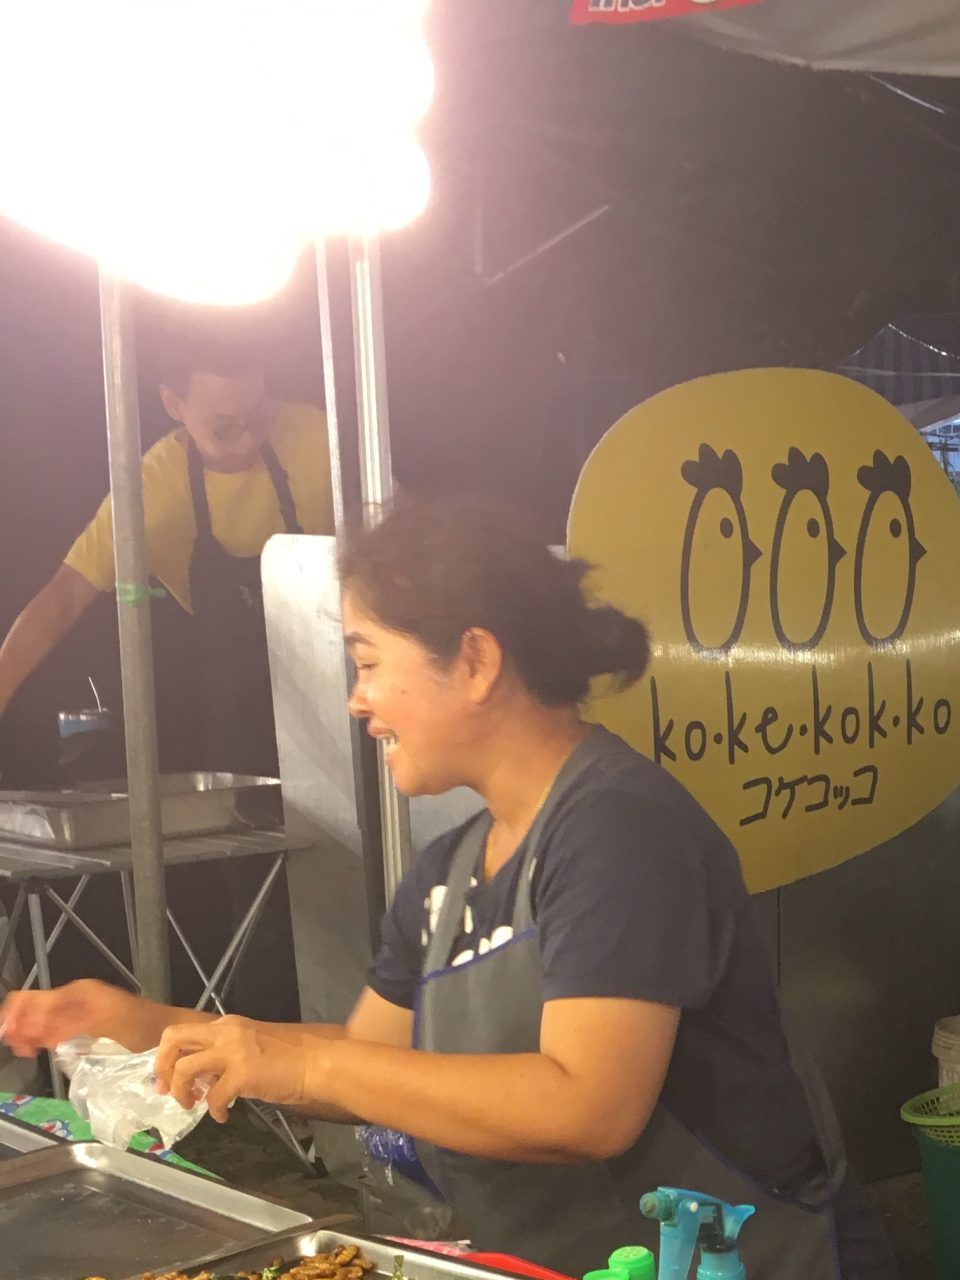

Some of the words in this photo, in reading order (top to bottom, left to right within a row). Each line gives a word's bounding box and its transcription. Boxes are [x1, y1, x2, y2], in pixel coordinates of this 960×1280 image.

[739, 765, 879, 827] コケコッコ
